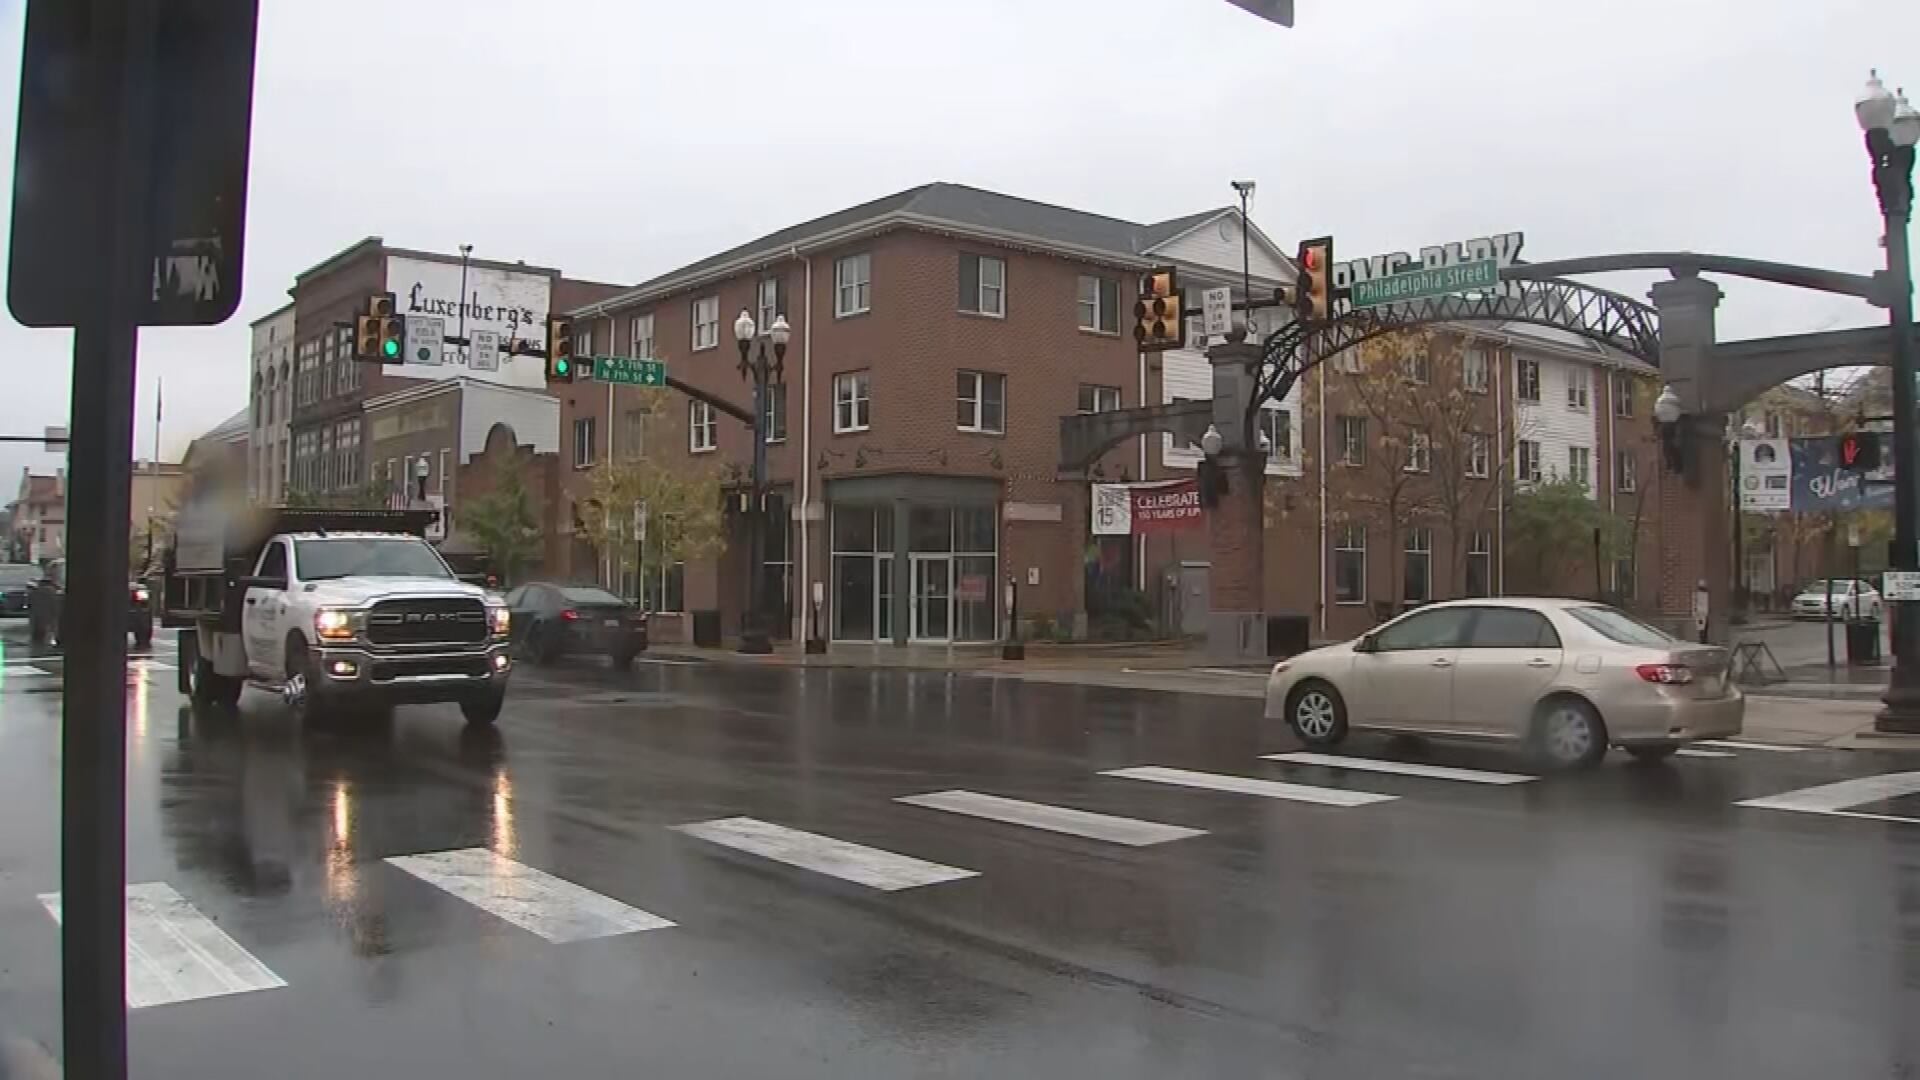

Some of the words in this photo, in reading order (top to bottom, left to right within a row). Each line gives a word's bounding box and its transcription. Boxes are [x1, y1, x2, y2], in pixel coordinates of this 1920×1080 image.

[1358, 272, 1442, 300] Philadelphia
[1447, 263, 1490, 286] Street
[407, 281, 533, 331] Luxenberg's
[1137, 491, 1200, 509] CELEBRATE
